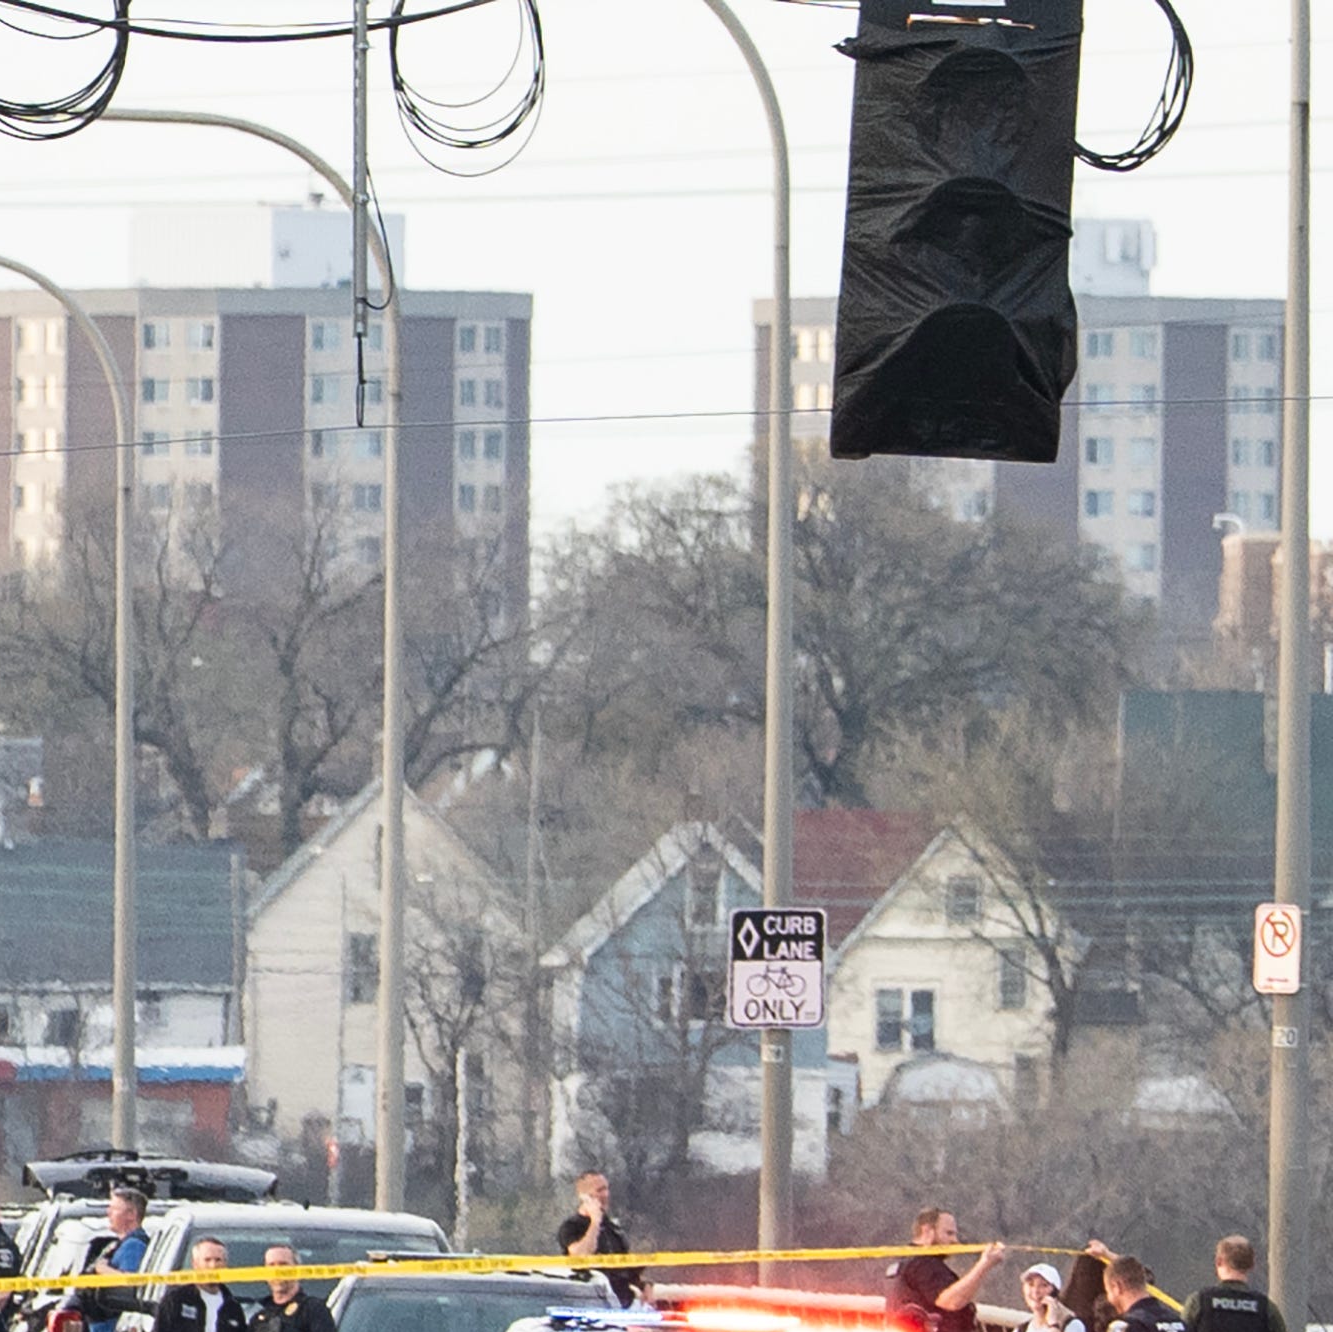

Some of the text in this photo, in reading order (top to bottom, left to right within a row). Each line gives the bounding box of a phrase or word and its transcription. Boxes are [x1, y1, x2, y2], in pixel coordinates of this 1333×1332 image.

[763, 916, 817, 935] CURB
[763, 940, 816, 960] LANE
[744, 999, 806, 1020] ONLY
[1212, 1297, 1259, 1312] POLICE
